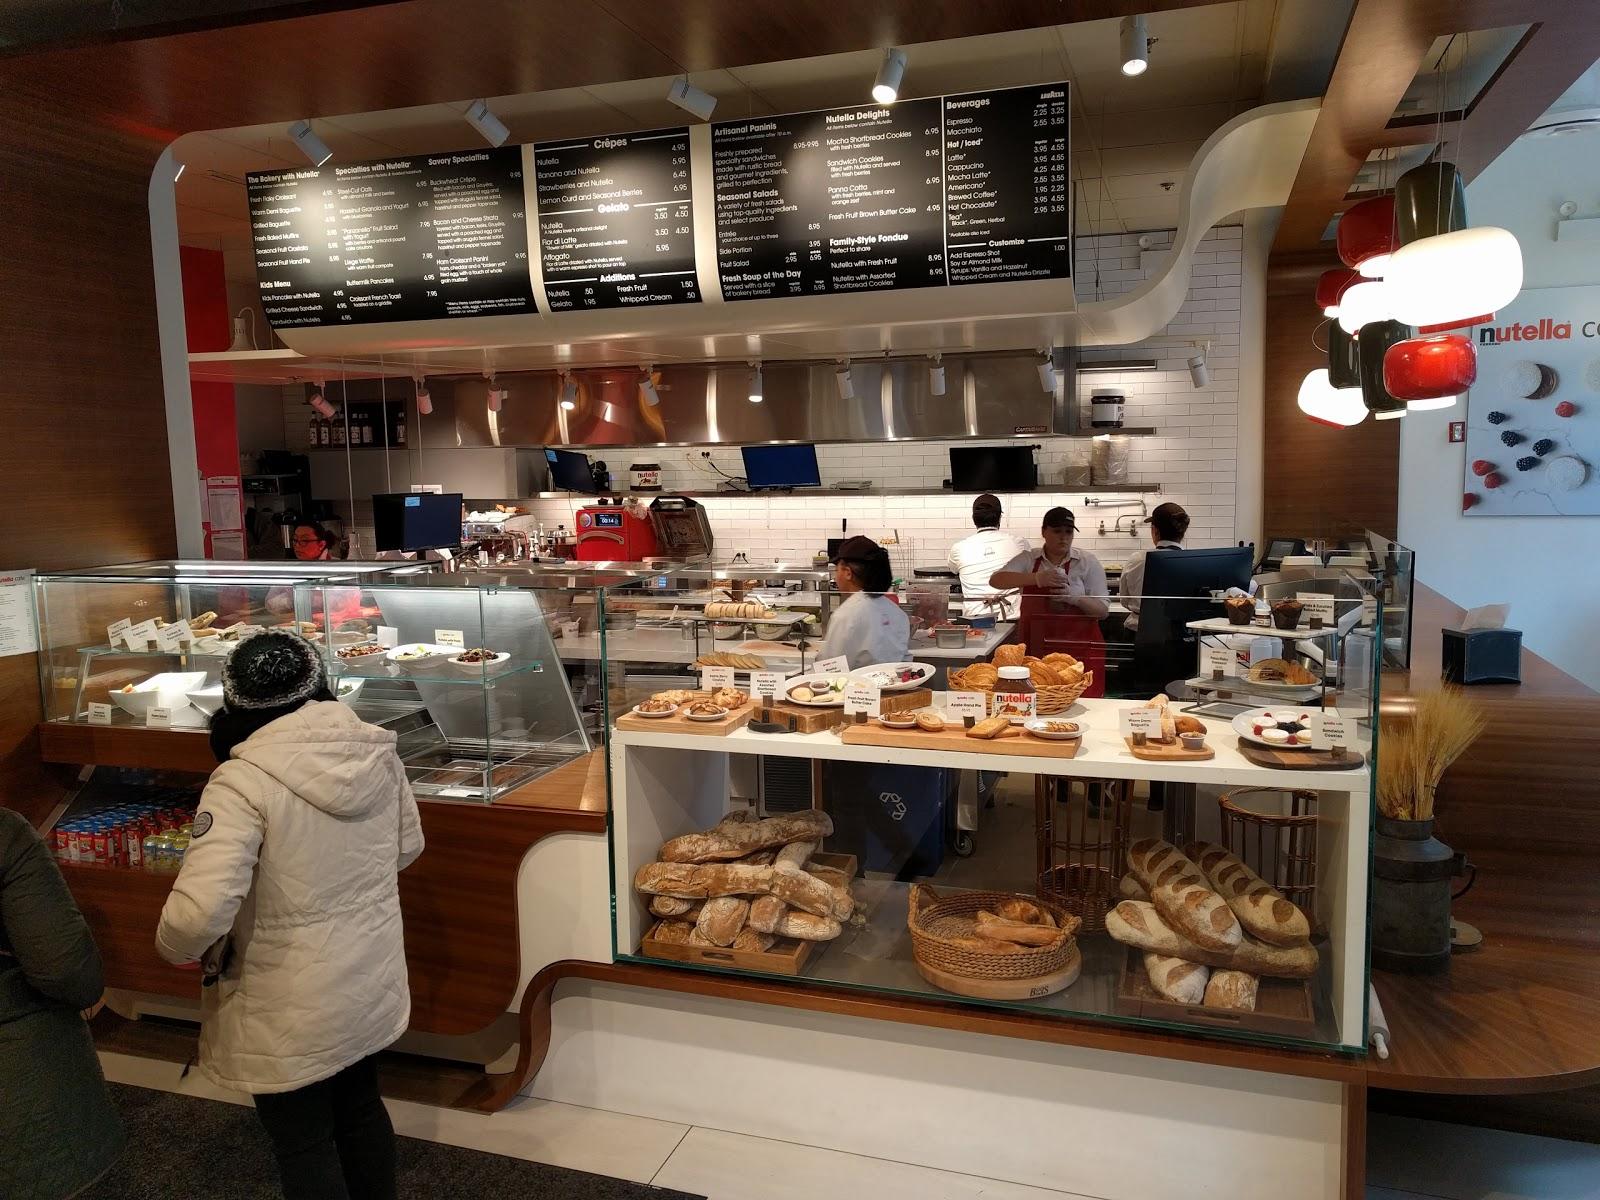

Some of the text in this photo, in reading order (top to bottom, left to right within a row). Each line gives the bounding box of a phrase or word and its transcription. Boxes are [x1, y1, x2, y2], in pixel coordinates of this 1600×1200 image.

[947, 99, 990, 109] Beverages
[826, 109, 890, 123] Nutella Delights
[715, 122, 776, 136] Artisanal Paninis
[947, 126, 982, 135] Macchiato
[850, 134, 885, 143] Shortbread
[594, 138, 627, 151] Crêpes
[428, 154, 489, 166] Savory Specialties
[537, 158, 559, 166] Nutella
[827, 158, 857, 166] Sandwich
[336, 164, 368, 176] Specialties
[369, 163, 384, 173] with
[578, 167, 600, 175] Nutella
[248, 175, 258, 185] The
[260, 174, 280, 184] Bakery
[282, 172, 295, 181] with
[539, 183, 575, 192] Strawberries
[591, 178, 613, 186] Nutella
[540, 197, 560, 205] Lemon
[579, 193, 591, 201] and
[593, 190, 621, 200] Seasonal
[622, 188, 642, 196] Berries
[717, 189, 778, 202] Seasonal Salads
[948, 192, 972, 200] Brewed
[598, 202, 629, 214] Gelato
[830, 233, 908, 247] Family-Style Fondue
[989, 238, 1025, 247] Customize
[543, 252, 570, 261] Affogato
[600, 273, 635, 283] Additions
[743, 273, 761, 281] Soup
[786, 270, 801, 278] Day
[635, 283, 647, 291] Fruit
[620, 295, 648, 303] Whipped
[1480, 319, 1572, 342] nutella
[997, 693, 1031, 702] nutella
